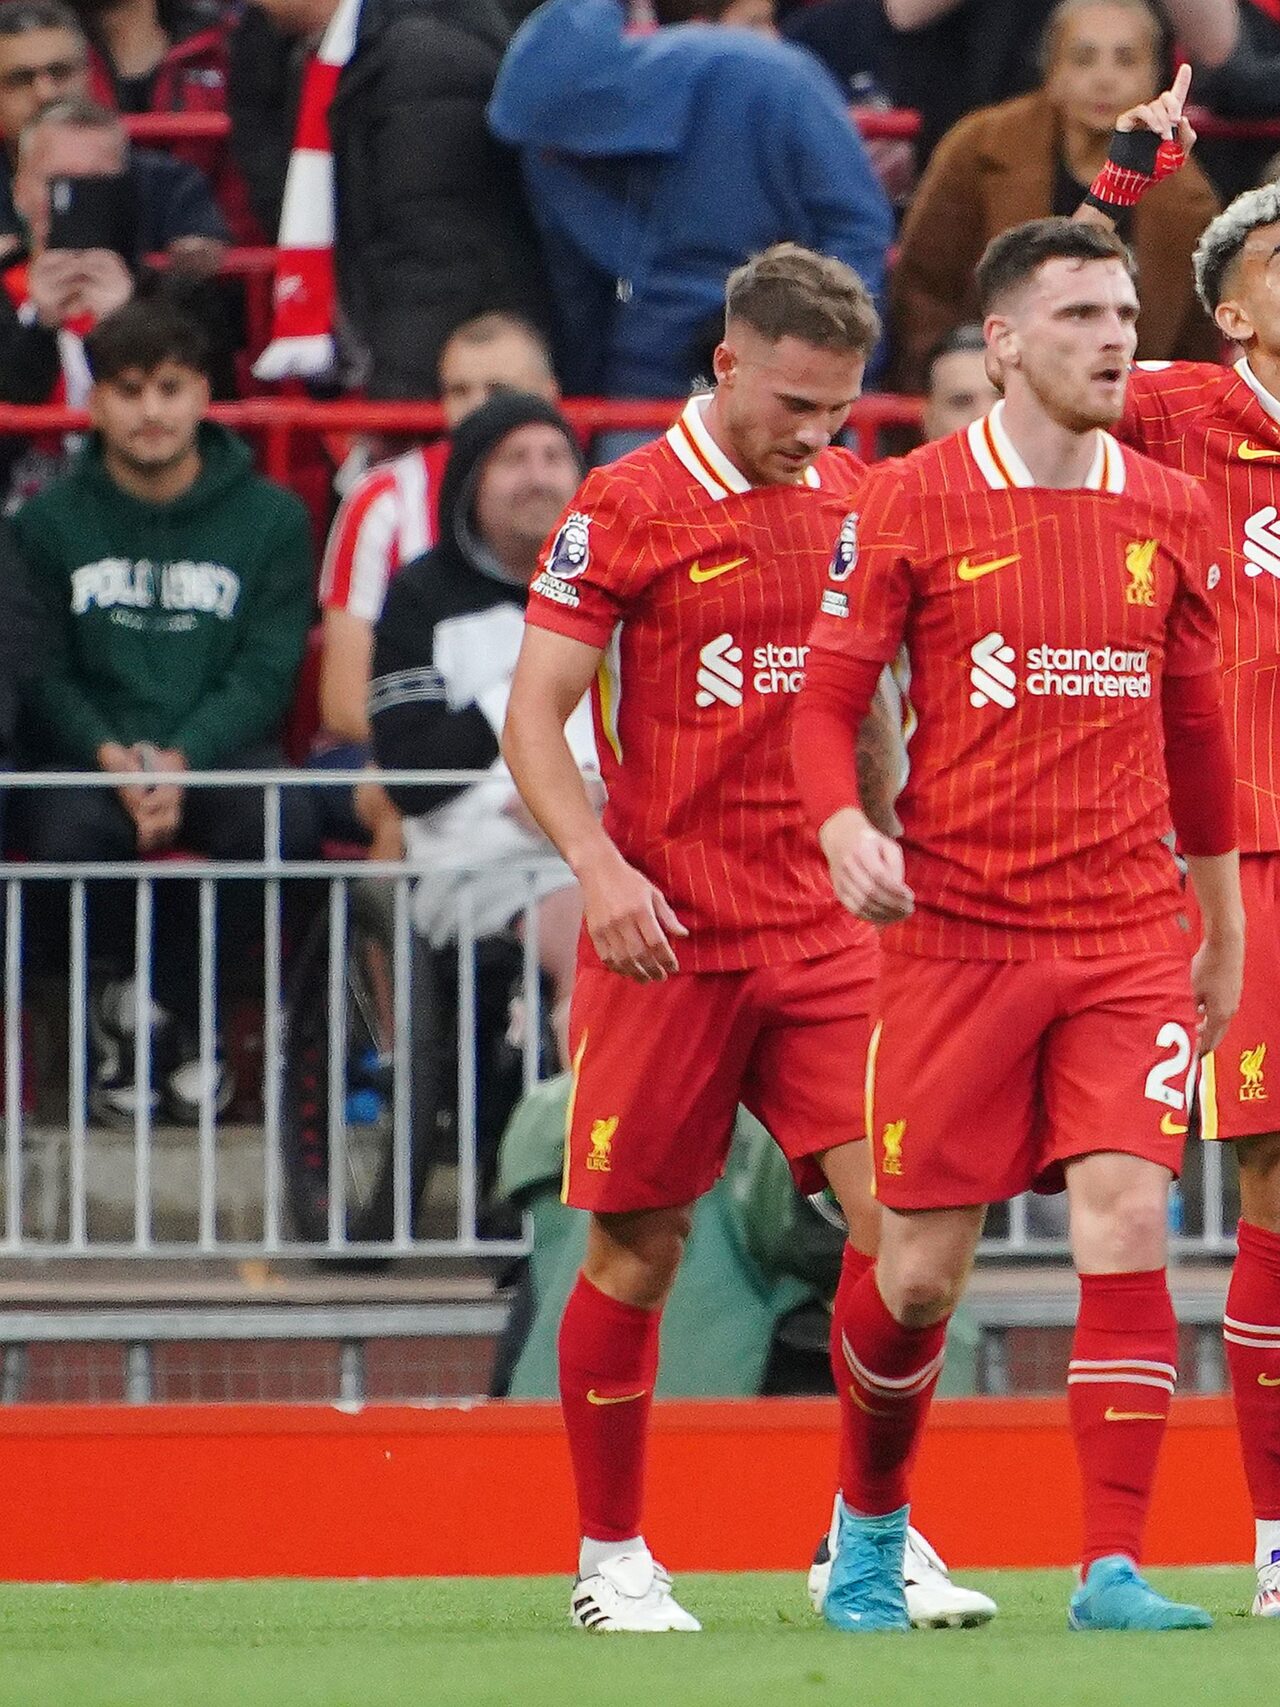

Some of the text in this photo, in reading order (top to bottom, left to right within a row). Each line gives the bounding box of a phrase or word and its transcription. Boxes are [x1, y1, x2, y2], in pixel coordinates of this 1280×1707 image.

[752, 641, 811, 669] star
[1026, 643, 1151, 673] standard
[1026, 670, 1151, 698] chartered
[1144, 1021, 1198, 1115] 2
